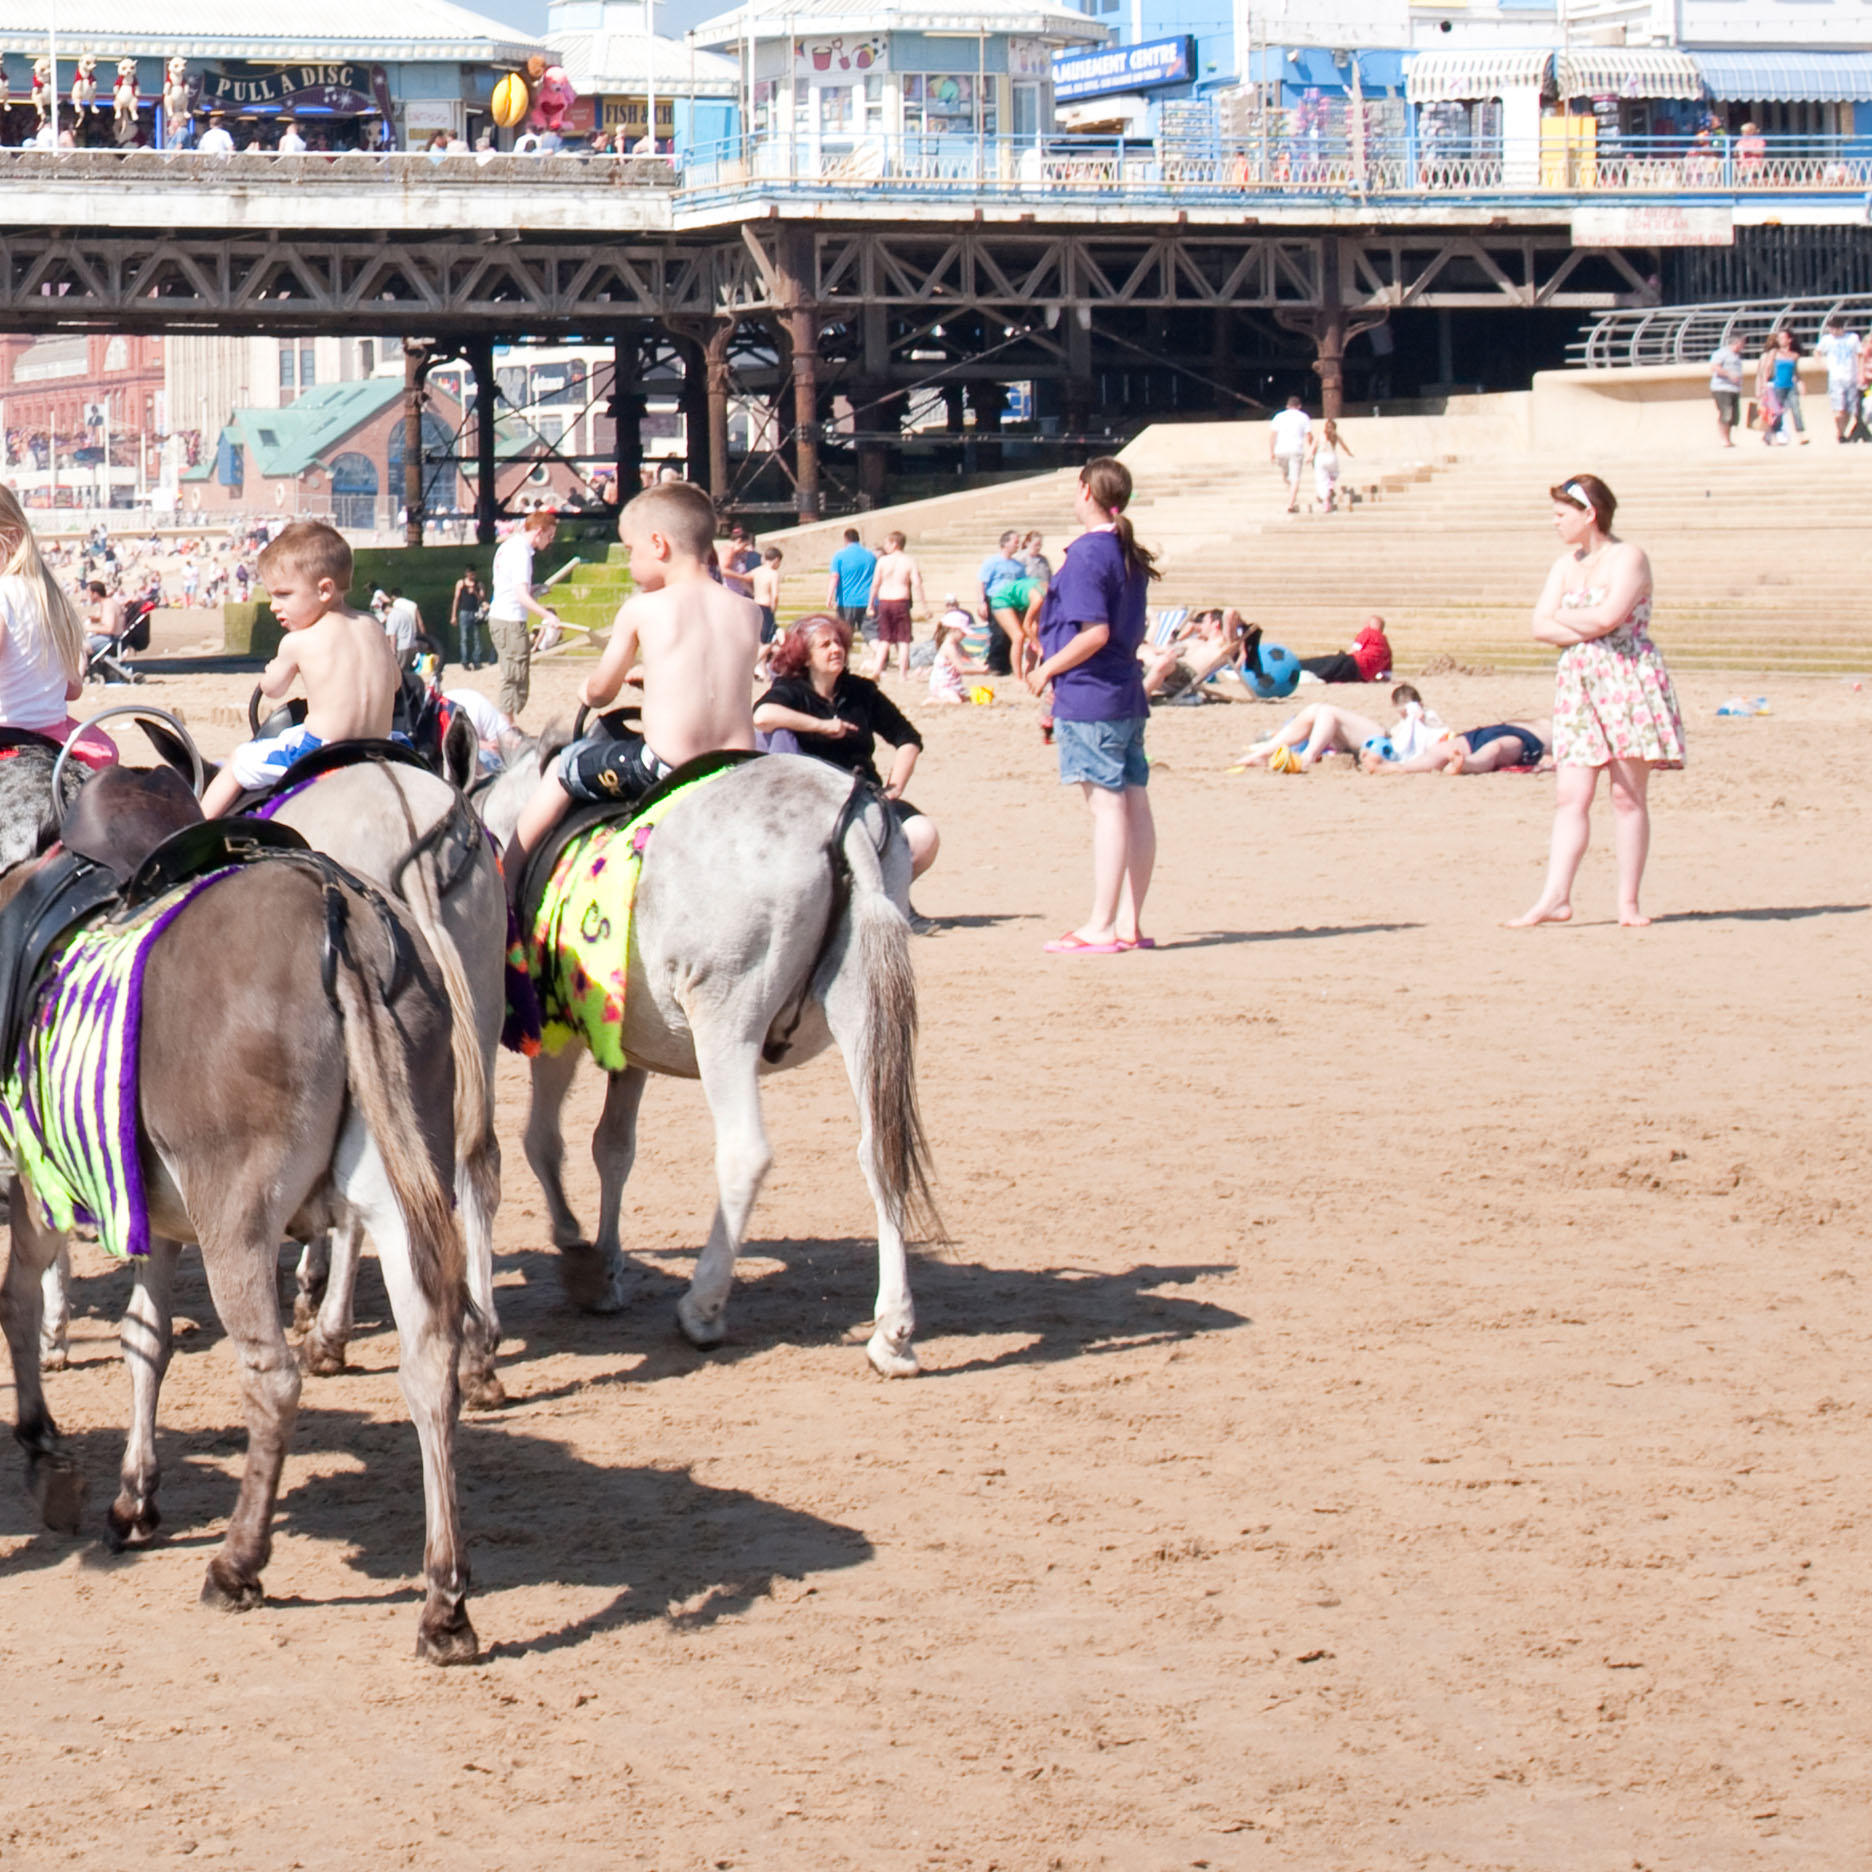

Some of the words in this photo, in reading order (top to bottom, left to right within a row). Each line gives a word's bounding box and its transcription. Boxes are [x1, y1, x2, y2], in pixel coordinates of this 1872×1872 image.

[1052, 52, 1128, 84] AMUSEMENT
[1129, 43, 1178, 70] CENTRE
[215, 78, 275, 102] PULL
[281, 72, 296, 94] A
[301, 65, 354, 87] DISC
[606, 104, 638, 124] FISH
